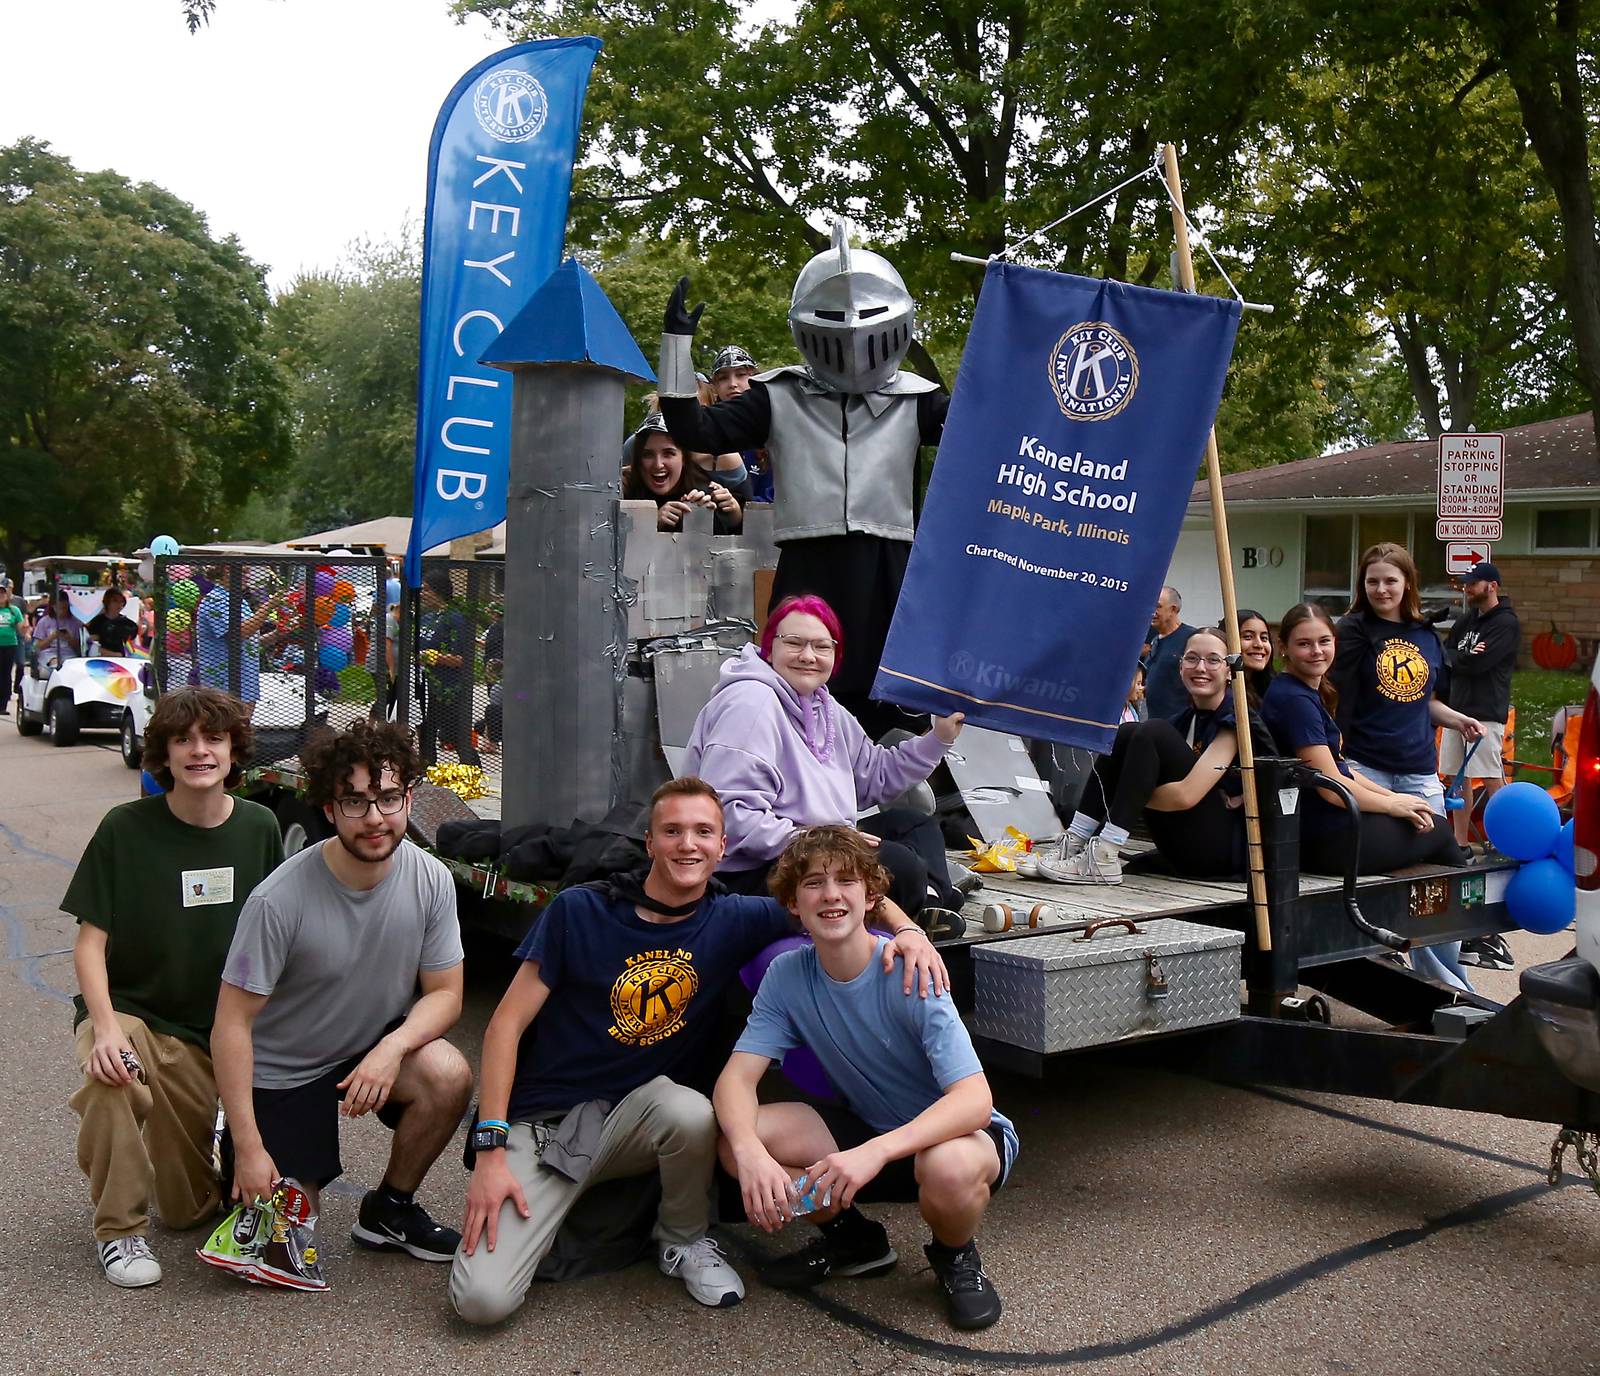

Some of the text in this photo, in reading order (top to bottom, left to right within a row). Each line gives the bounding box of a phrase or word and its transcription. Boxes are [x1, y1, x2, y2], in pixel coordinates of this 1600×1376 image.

[479, 95, 542, 137] INTERNATIONAL
[436, 155, 526, 501] KEY CLUB
[1071, 330, 1127, 361] KEY CLUB
[1056, 353, 1130, 412] INTERNATIONAL
[1447, 451, 1495, 460] PARKING
[1464, 439, 1479, 448] NO
[1018, 436, 1128, 481] Kaneland
[1443, 462, 1499, 472] STOPPING
[997, 463, 1137, 514] High School
[1443, 485, 1498, 494] STANDING
[1464, 474, 1477, 482] OR
[987, 499, 1130, 545] Maple Park, Illinois
[1440, 525, 1498, 535] ON SCHOOL DAYS
[965, 544, 1129, 592] Chartered November 20, 2015
[975, 660, 1080, 703] Kiwanis
[1376, 684, 1426, 703] HIGH SCHOOL
[629, 966, 686, 987] KEY CLUB
[639, 1020, 687, 1047] SCHOOL
